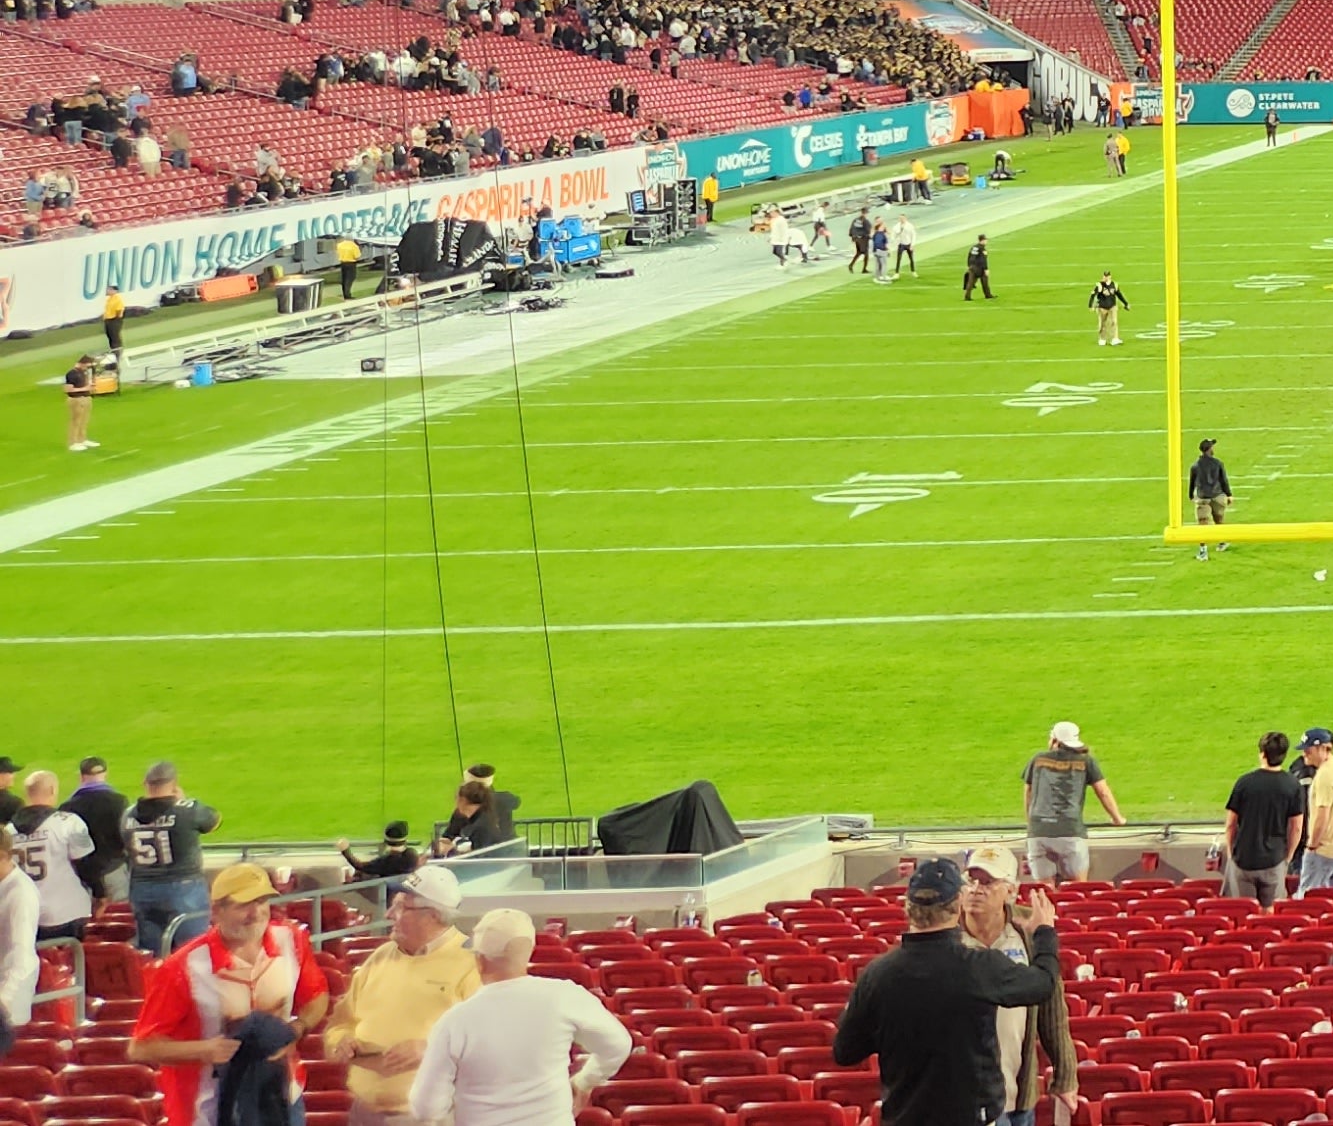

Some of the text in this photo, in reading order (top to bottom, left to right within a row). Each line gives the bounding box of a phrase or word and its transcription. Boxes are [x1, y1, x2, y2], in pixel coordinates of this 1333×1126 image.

[1258, 102, 1321, 110] CLEARWATER
[809, 131, 844, 153] CELSIUS
[83, 238, 184, 301] UNION
[194, 224, 287, 276] HOME
[436, 176, 553, 223] GASPARILLA
[558, 165, 609, 209] BOWL
[1002, 381, 1124, 409] 20
[812, 470, 964, 505] 10
[131, 829, 175, 866] 51
